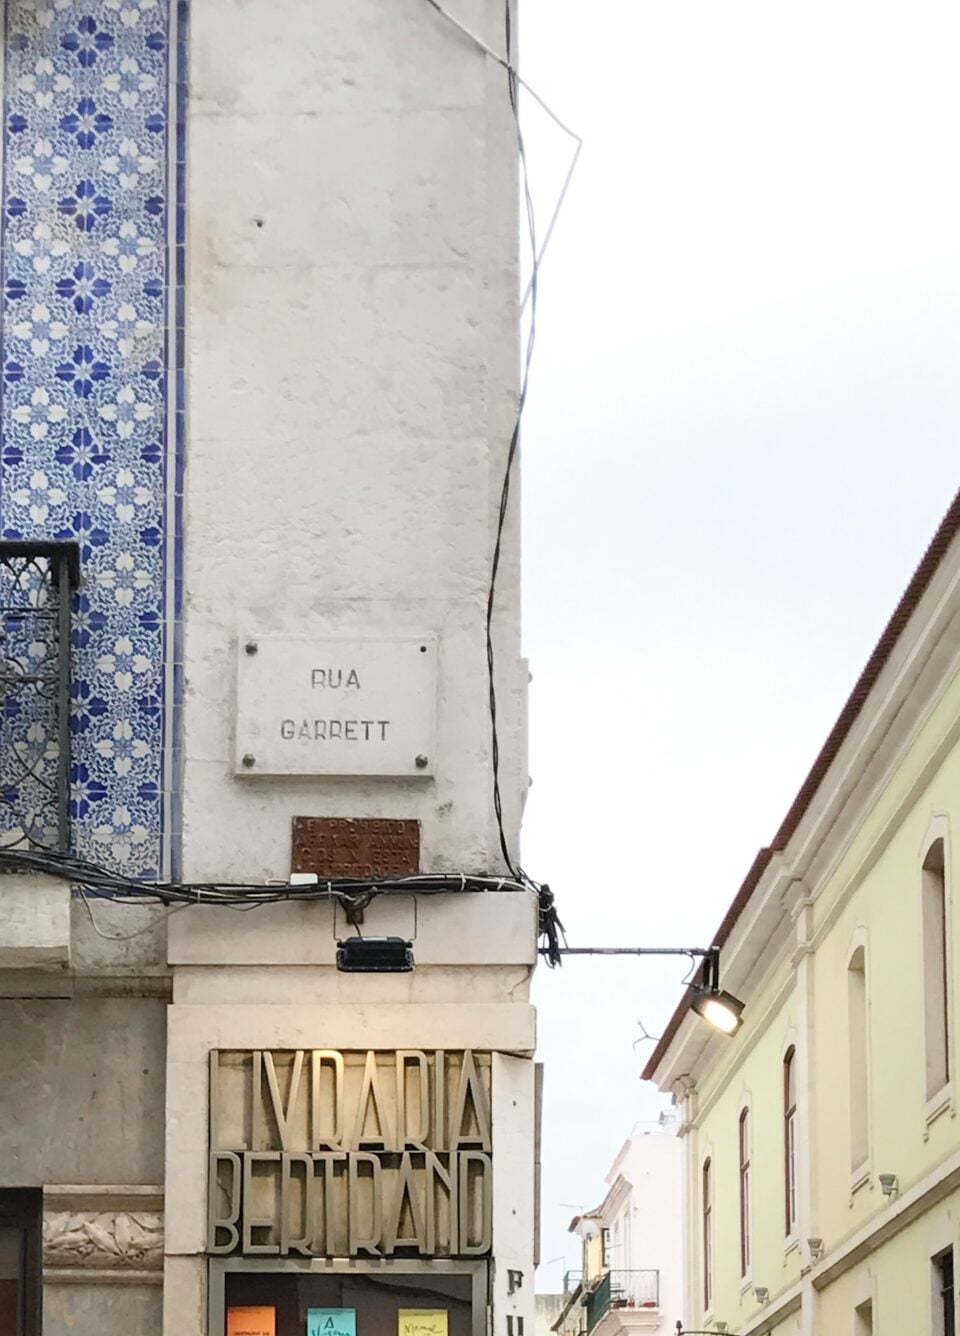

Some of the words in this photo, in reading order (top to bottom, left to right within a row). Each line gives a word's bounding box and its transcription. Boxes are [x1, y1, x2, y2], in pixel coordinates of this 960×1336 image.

[311, 668, 361, 689] RUA
[280, 719, 391, 741] GARRETT
[210, 1049, 492, 1150] LIVRARIA
[206, 1151, 492, 1255] BERTRAND
[324, 1316, 334, 1329] A
